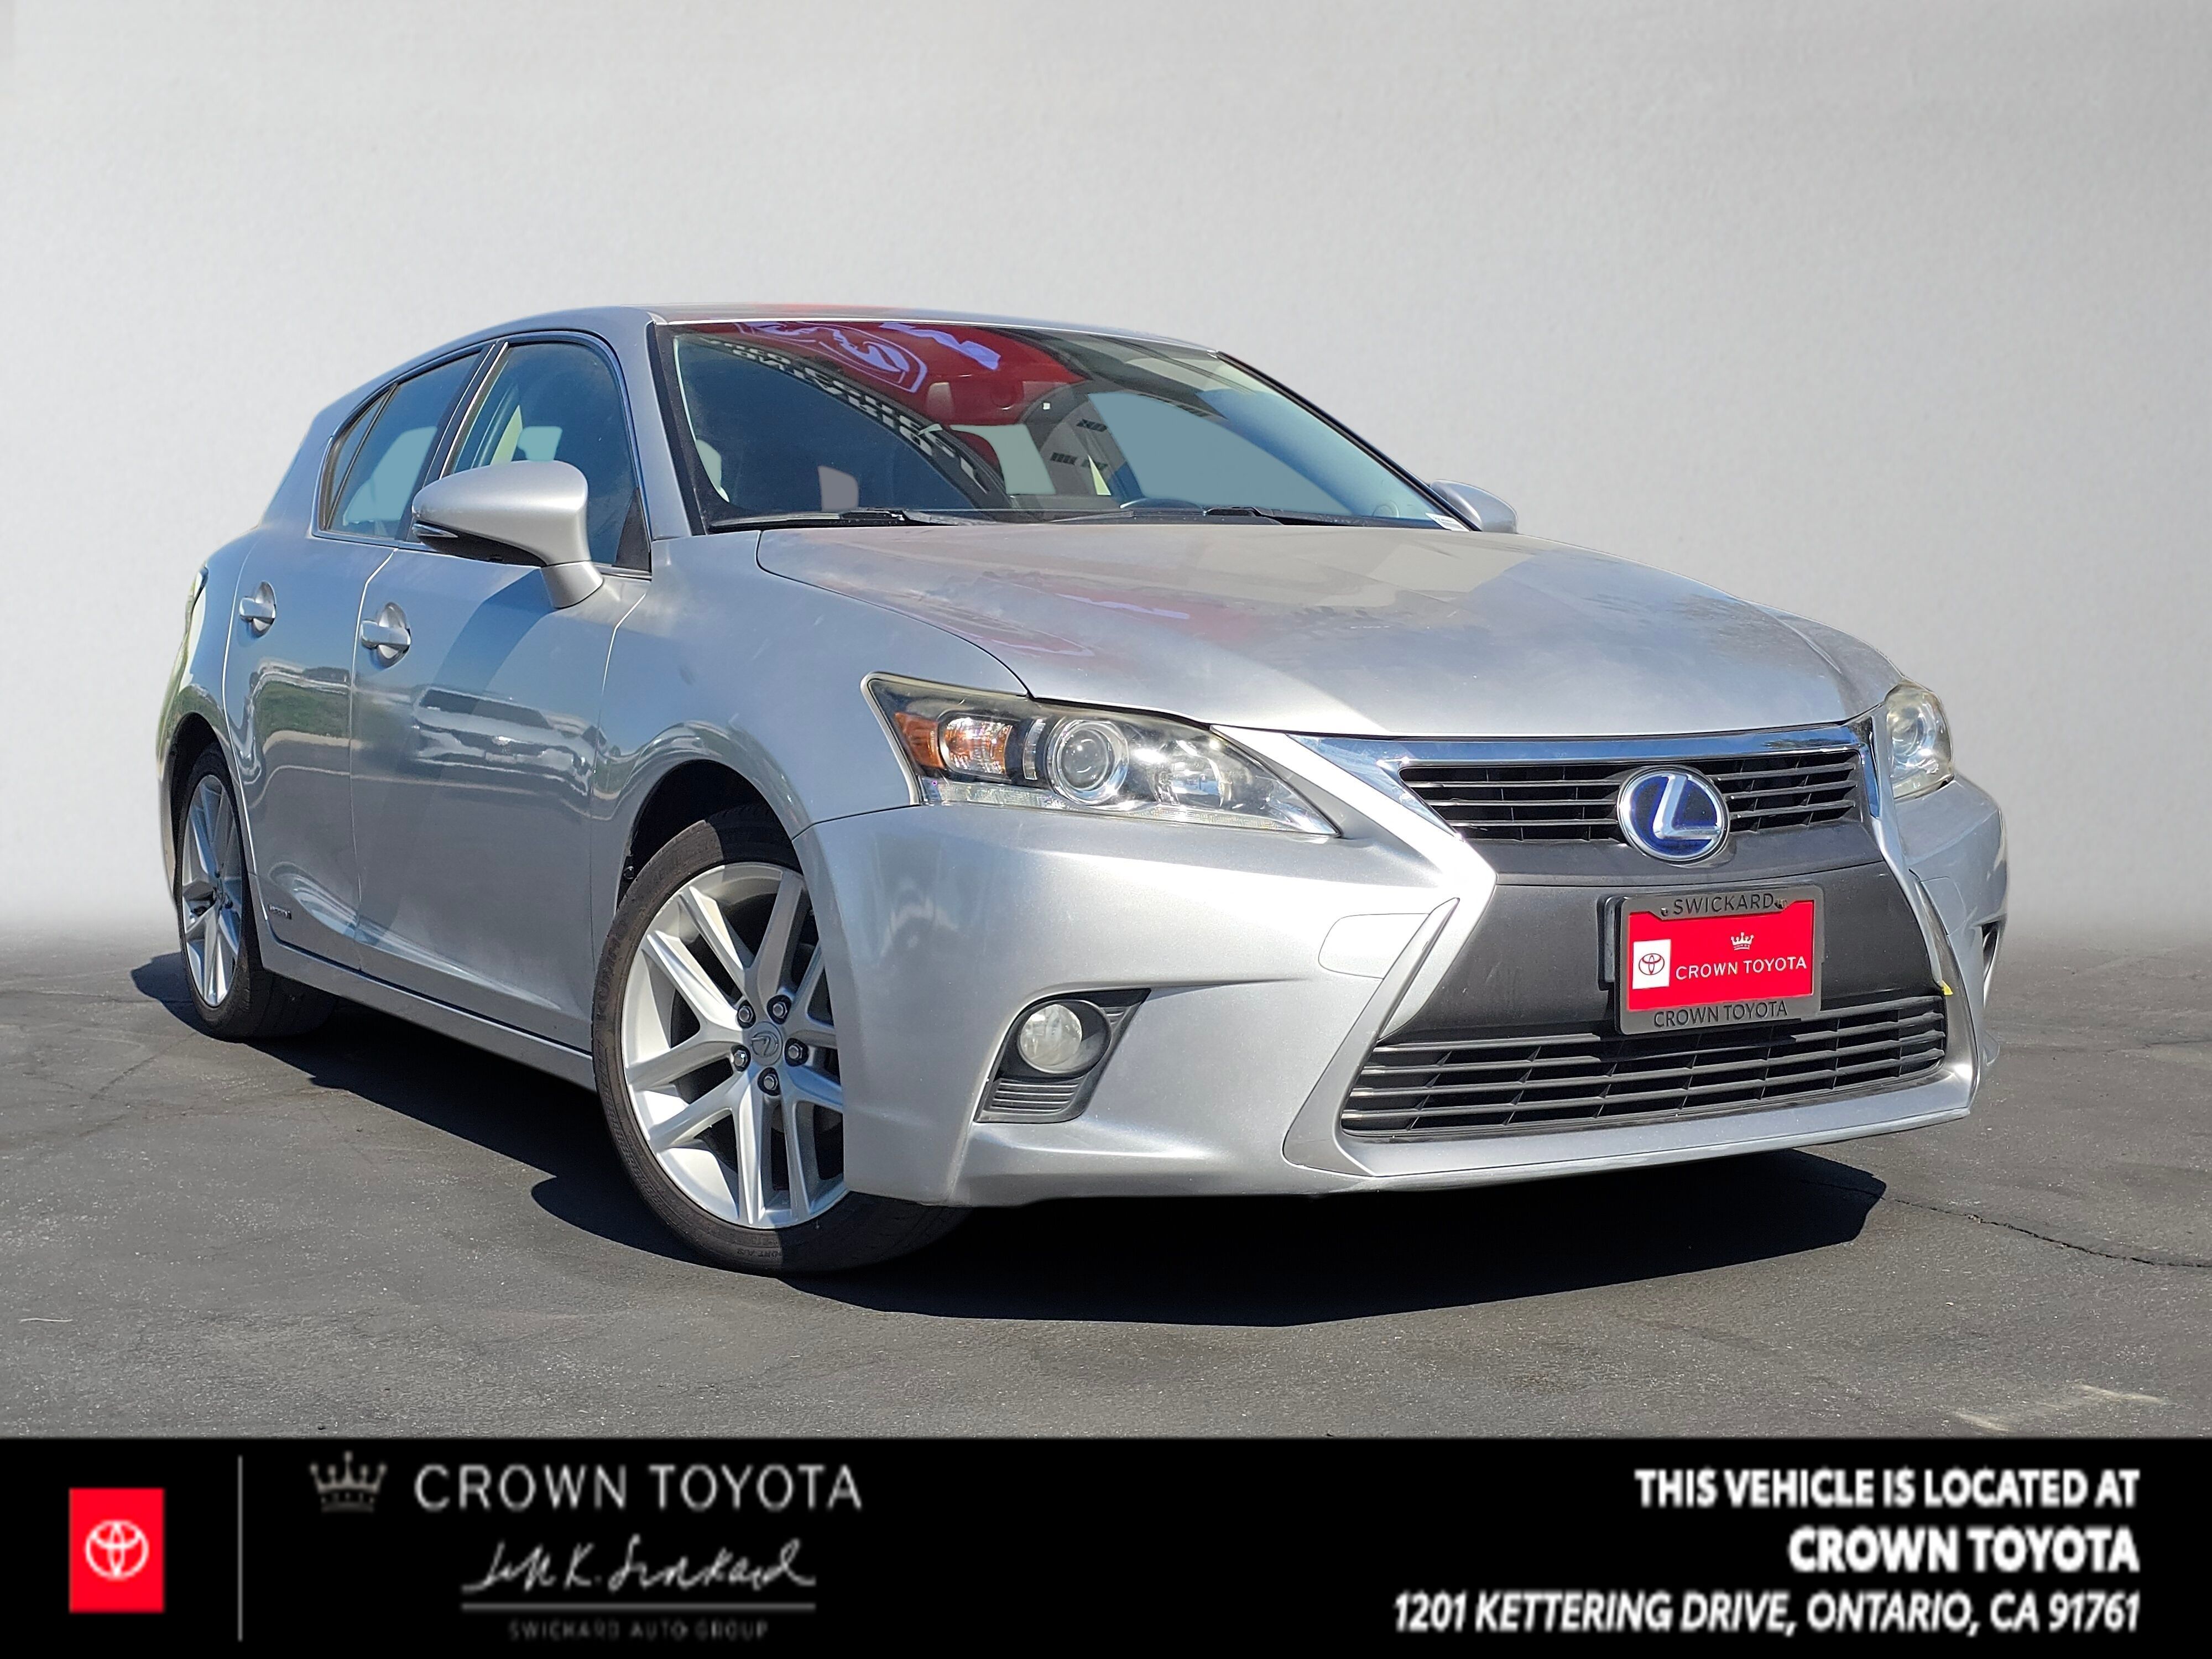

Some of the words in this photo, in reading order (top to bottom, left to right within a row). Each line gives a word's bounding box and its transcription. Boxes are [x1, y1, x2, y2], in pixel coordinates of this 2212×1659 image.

[1673, 893, 1774, 916] SWICKARD
[1653, 1005, 1719, 1027] CROWN
[1724, 1000, 1788, 1021] TOYOTA
